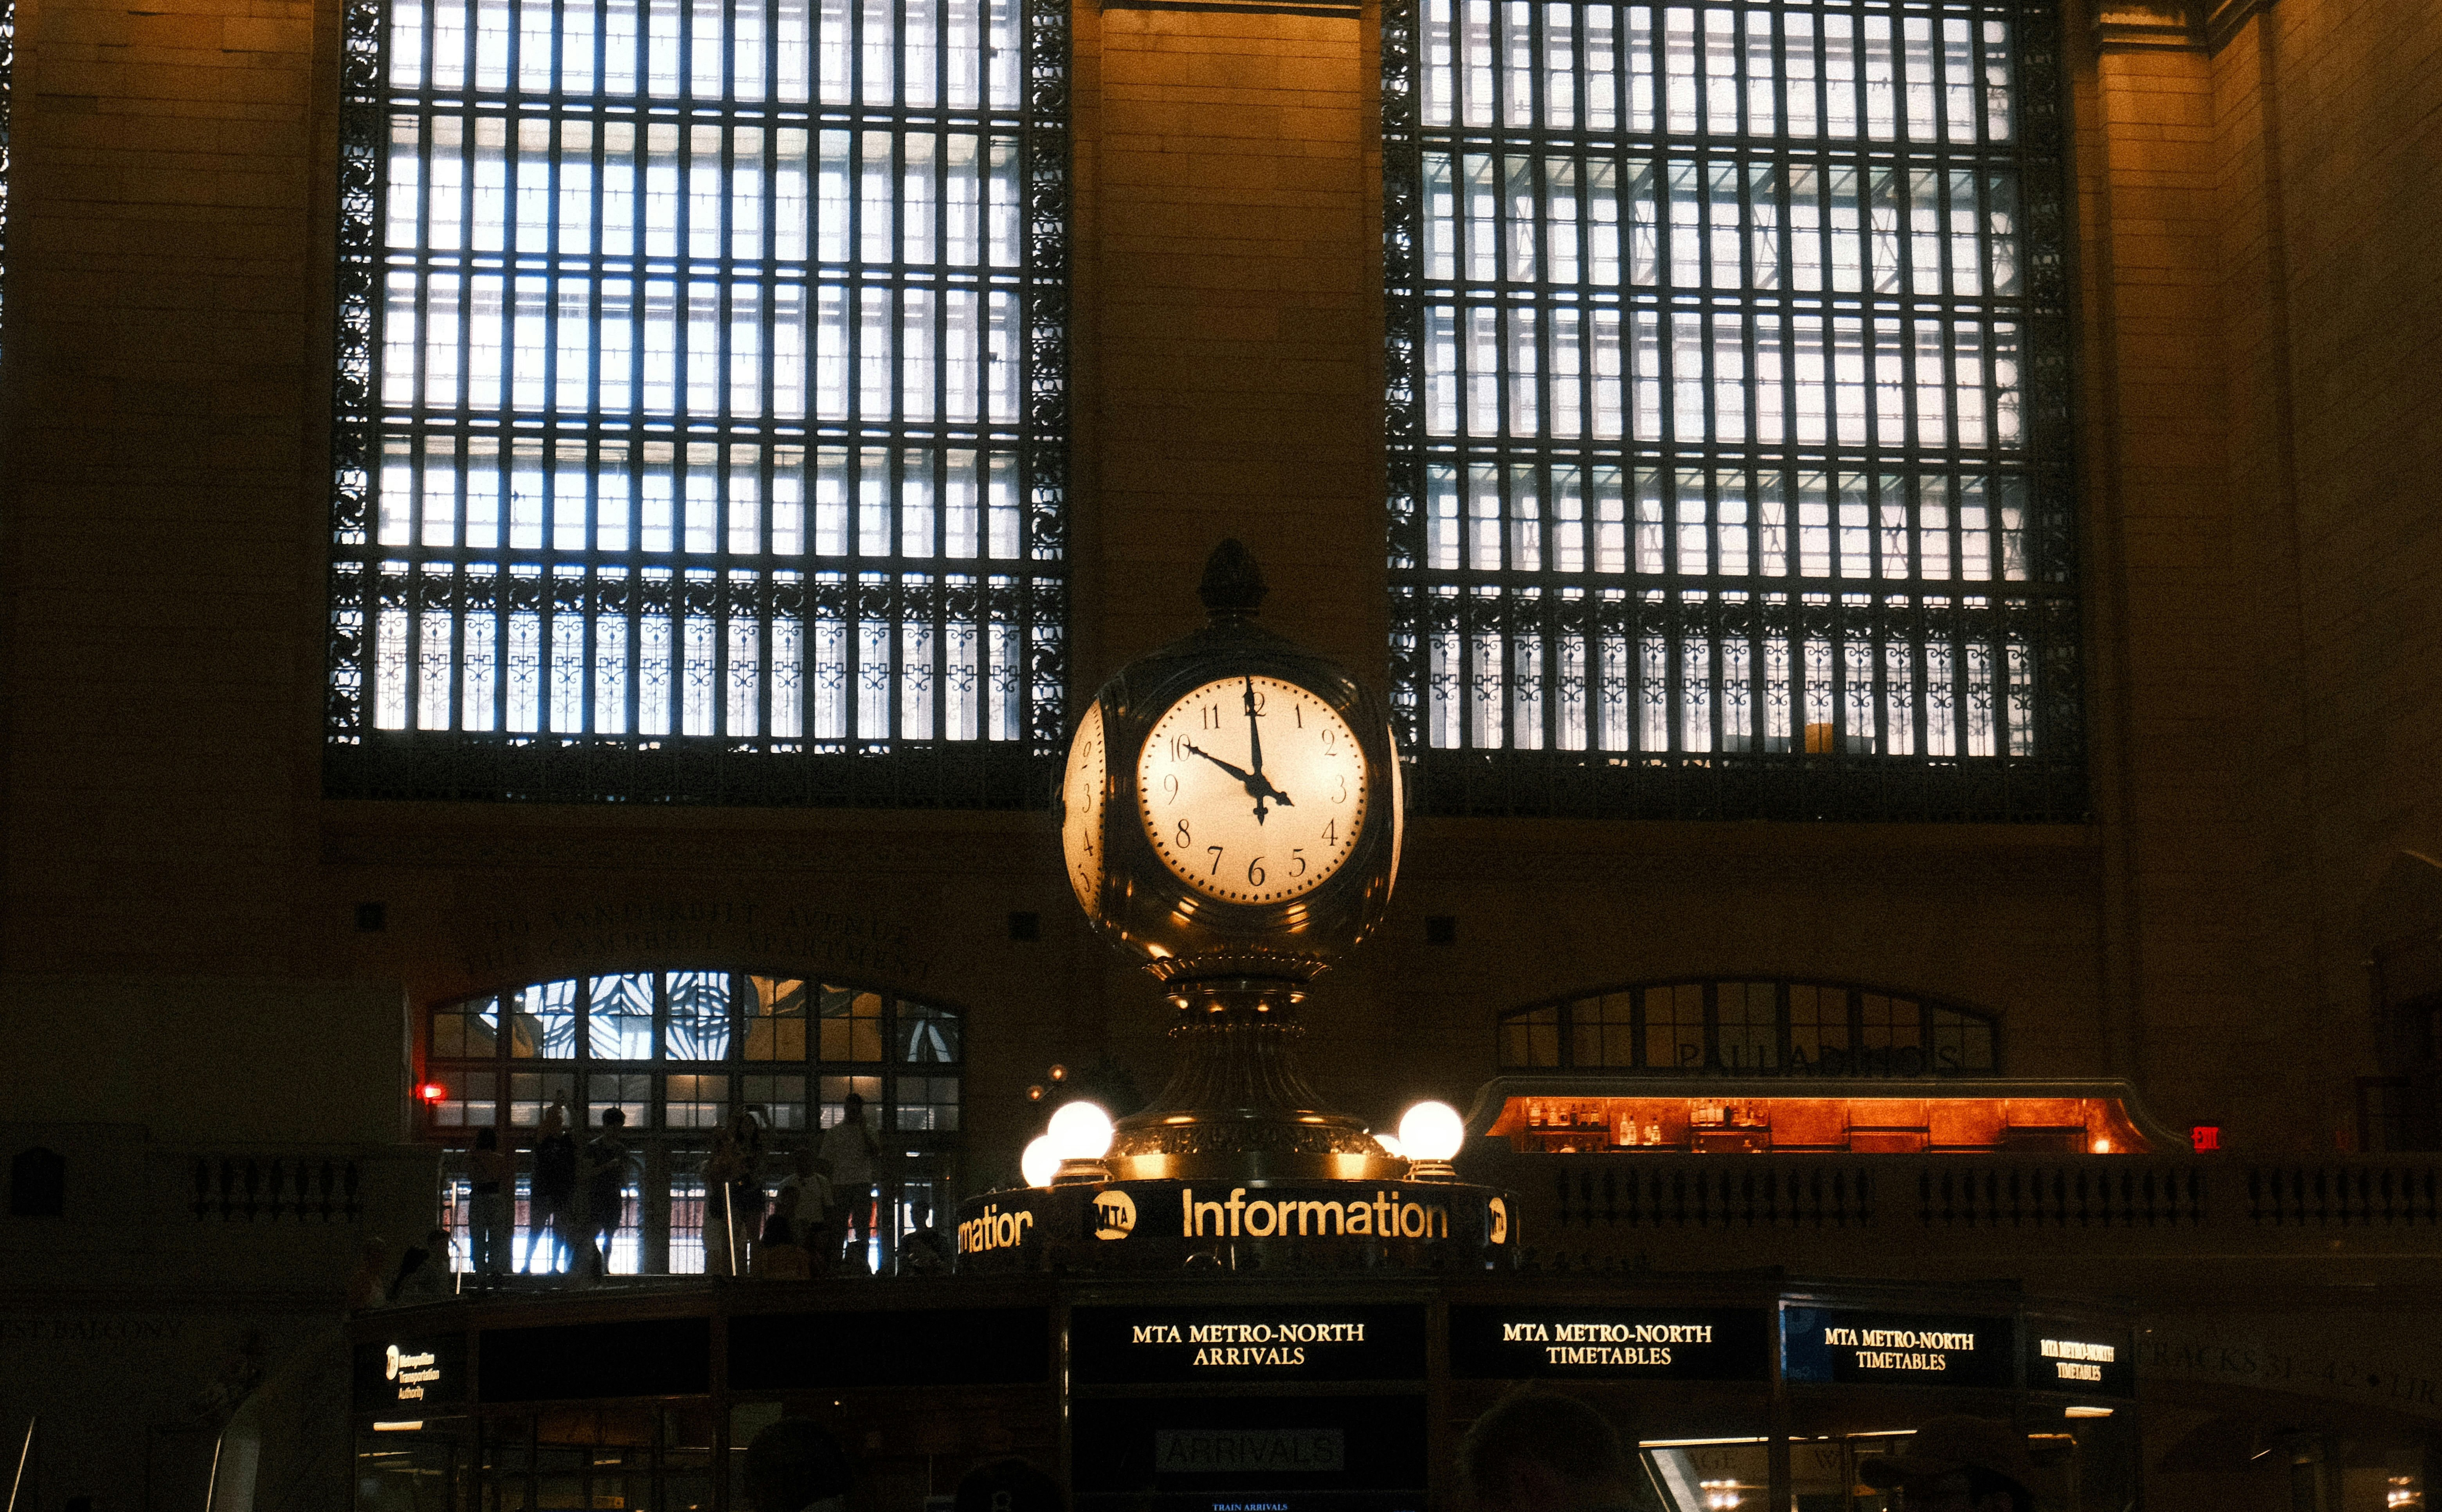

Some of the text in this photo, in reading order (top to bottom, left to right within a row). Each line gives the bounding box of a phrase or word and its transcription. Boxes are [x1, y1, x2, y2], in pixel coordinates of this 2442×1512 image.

[1201, 703, 1220, 730] 11
[1295, 703, 1303, 729] 1
[1170, 734, 1192, 762] 10
[1322, 729, 1337, 756] 2
[1164, 774, 1178, 805] 9
[1331, 774, 1347, 804] 3
[1176, 819, 1191, 849] 8
[1321, 817, 1338, 846] 4
[1207, 846, 1224, 875] 7
[1248, 857, 1266, 887] 6
[1289, 848, 1306, 877] 5
[1182, 1188, 1447, 1238] Information
[1133, 1324, 1364, 1343] MTA METRO-NORTH
[1503, 1323, 1712, 1343] MTA METRO-NORTH
[1824, 1328, 1974, 1350] MTA METRO-NORTH
[1193, 1347, 1305, 1365] ARRIVALS
[1546, 1346, 1671, 1365] TIMETABLES
[1855, 1351, 1946, 1371] TIMETABLES
[1167, 1436, 1333, 1463] ARRIVALS
